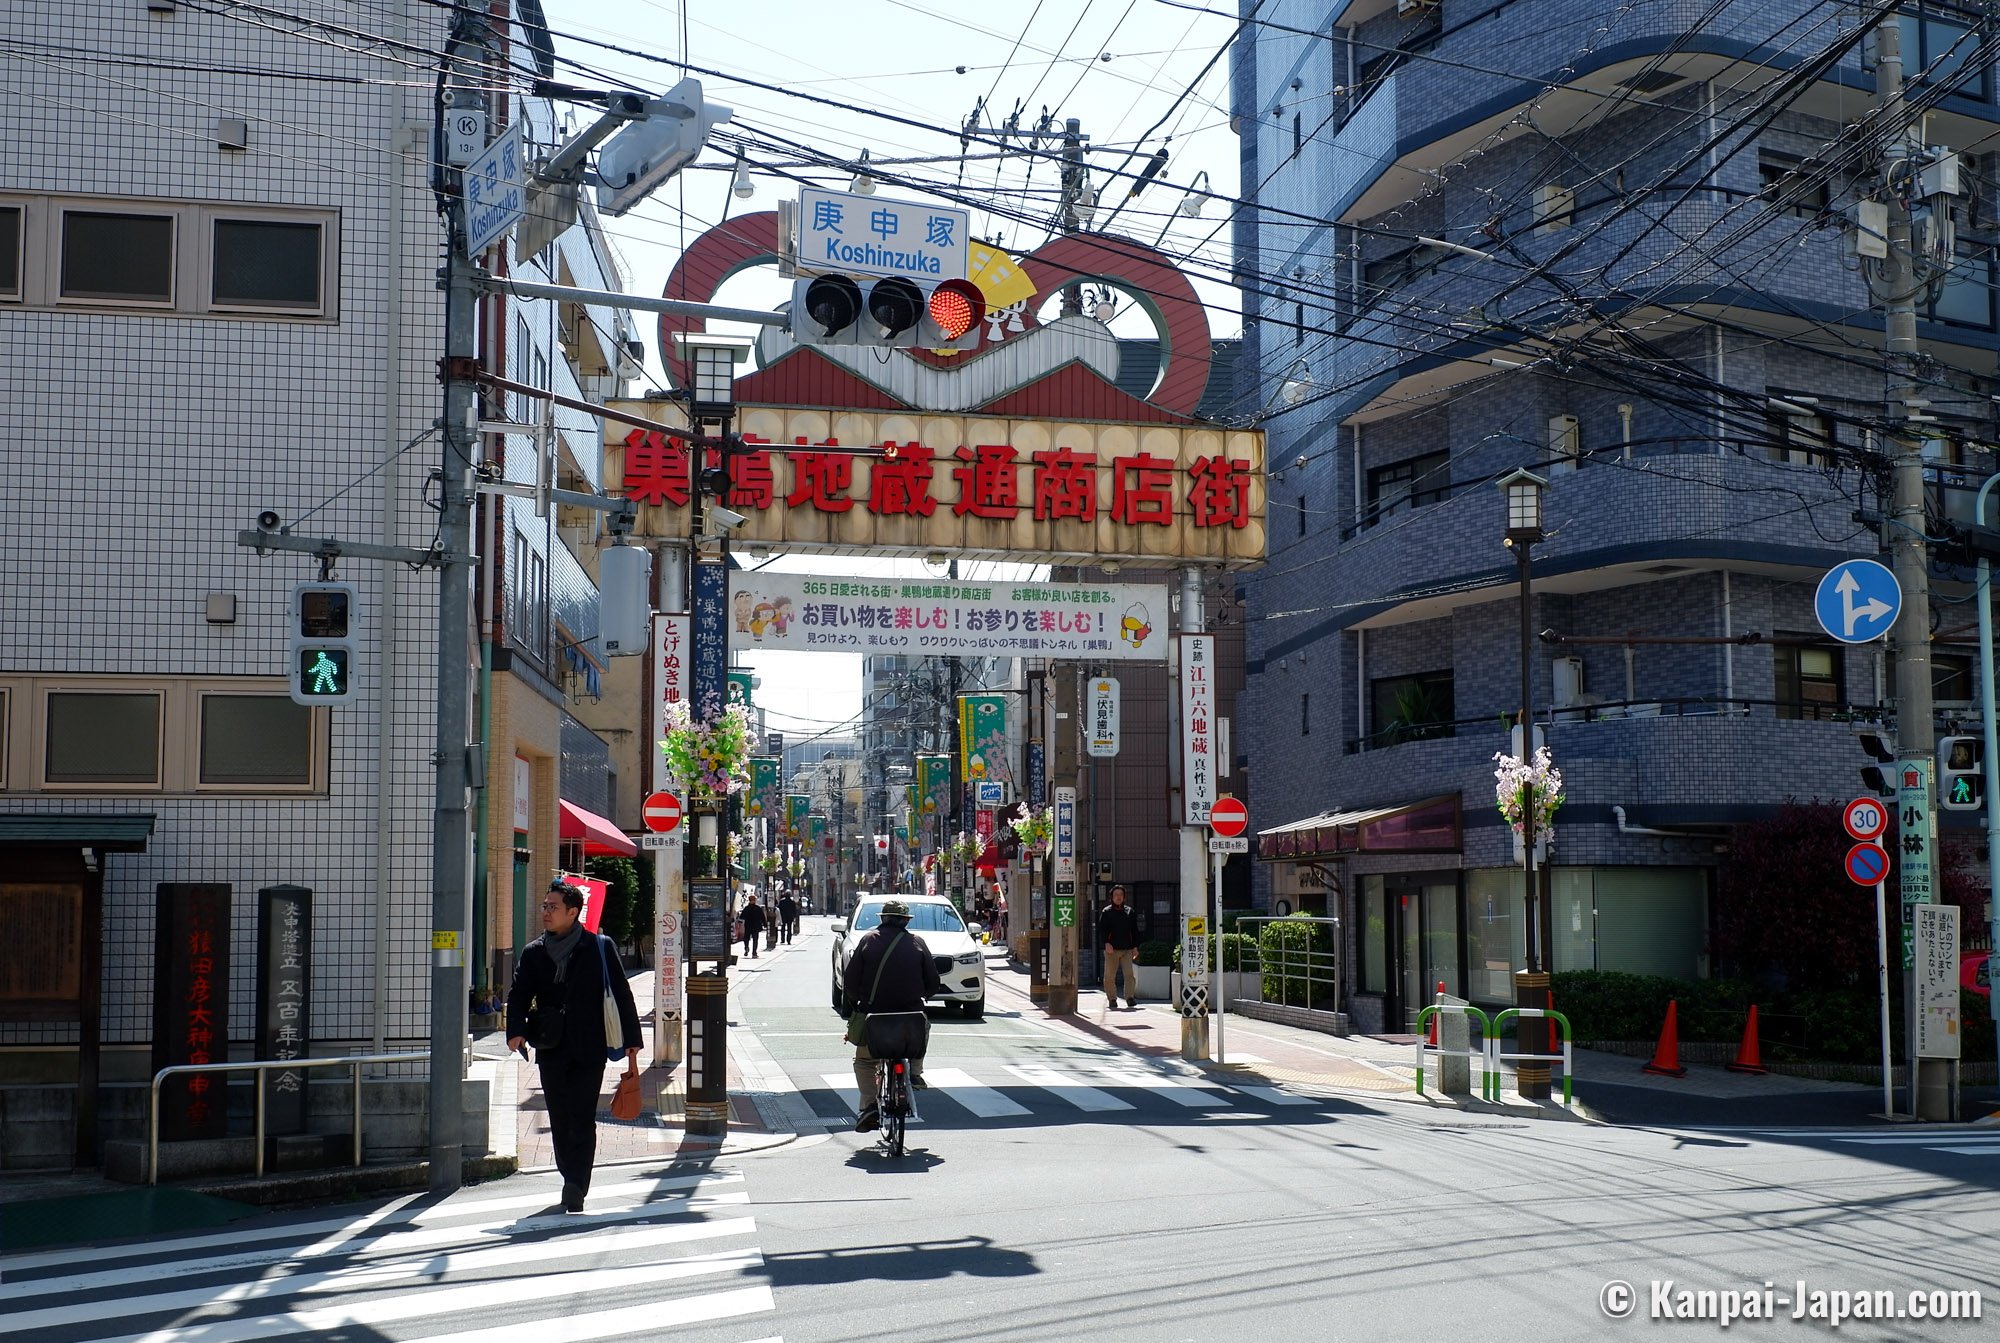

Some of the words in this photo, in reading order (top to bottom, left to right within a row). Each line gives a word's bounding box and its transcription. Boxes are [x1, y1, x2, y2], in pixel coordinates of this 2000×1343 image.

[469, 139, 517, 214] 庚申塚
[471, 188, 518, 244] Koshinzuka
[812, 200, 956, 248] 庚申塚
[826, 237, 941, 274] Koshinzuka
[623, 428, 1250, 528] 巣鴨地蔵通商店街
[1192, 639, 1204, 662] 史跡
[1097, 699, 1108, 740] 伏見歯科
[1190, 665, 1208, 755] 江戸六地蔵
[1194, 758, 1207, 798] 真性寺
[1059, 807, 1072, 854] 補聴器
[1854, 810, 1877, 829] 30
[1902, 806, 1924, 855] 小林
[645, 837, 680, 847] 自転車を除く
[1212, 840, 1246, 850] 自転車を除く
[1058, 906, 1073, 922] 文
[1197, 936, 1205, 976] 防犯カメラ
[1945, 913, 1953, 971] ハトのフンで
